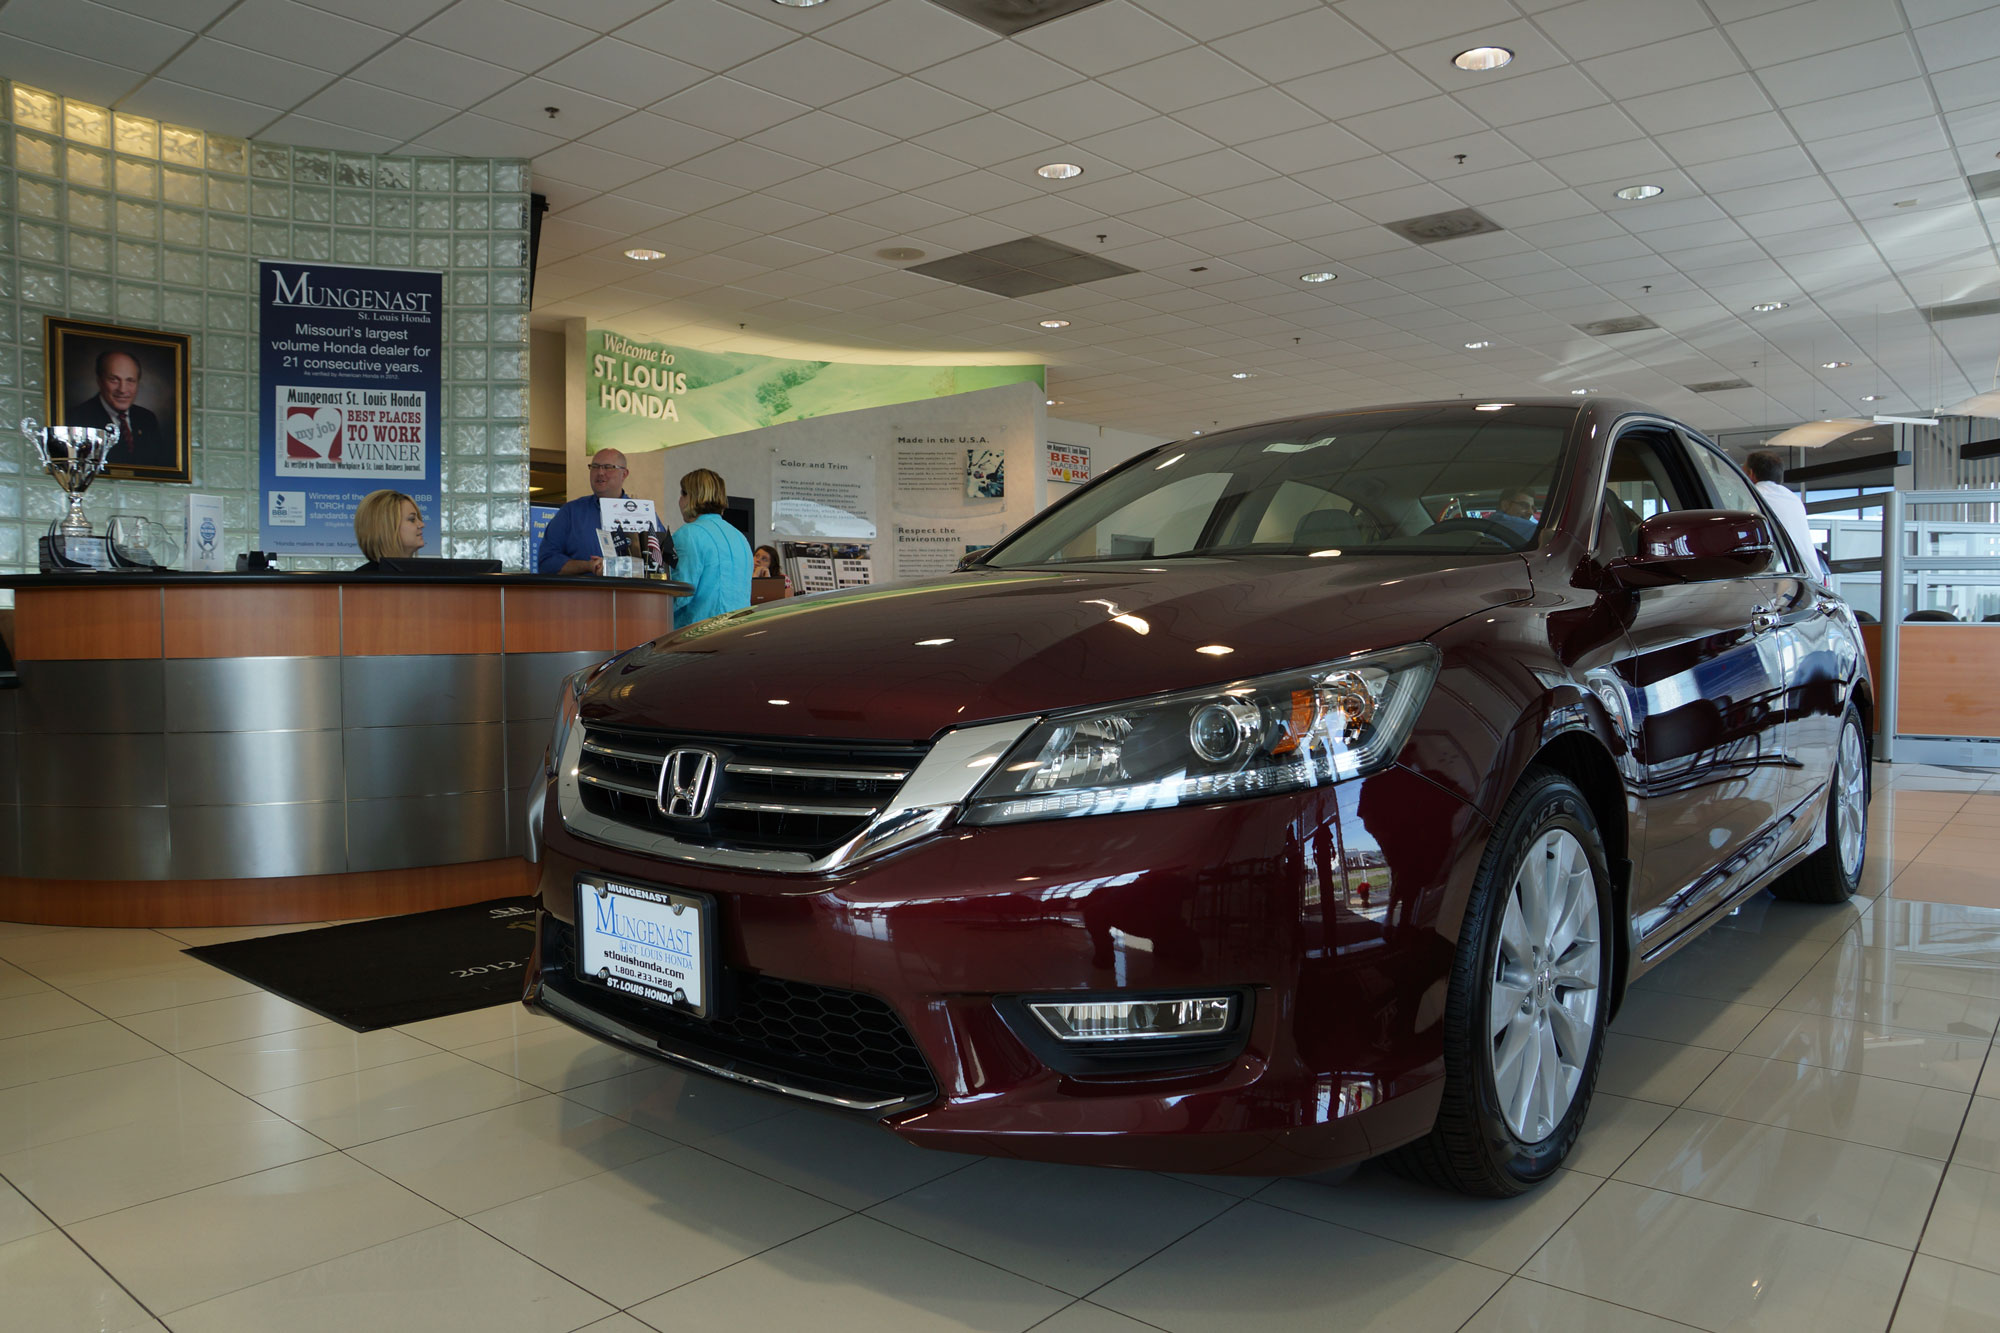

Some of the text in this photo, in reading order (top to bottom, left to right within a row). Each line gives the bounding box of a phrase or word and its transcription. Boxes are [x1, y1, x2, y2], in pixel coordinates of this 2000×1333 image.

[272, 270, 432, 312] MUNGENAST
[358, 312, 431, 323] St. Louis Honda
[295, 323, 408, 342] Missouri's largest
[271, 340, 431, 357] volume Honda dealer for
[604, 333, 675, 366] Welcome to
[282, 356, 423, 374] 21 consecutive years.
[594, 354, 687, 395] ST. LOUIS
[287, 388, 421, 407] Mungenast St. Louis Honda
[601, 385, 679, 422] HONDA
[347, 410, 421, 424] BEST PLACES
[295, 421, 336, 441] my job
[347, 425, 421, 443] TO WORK
[897, 436, 923, 444] Made
[938, 436, 955, 444] the
[958, 436, 990, 444] U.S.A.
[347, 443, 421, 462] WINNER
[1050, 452, 1088, 465] BEST
[780, 459, 848, 470] Color and Trim
[1050, 461, 1079, 470] PLACES
[308, 492, 340, 500] Winners
[415, 494, 433, 502] BBB
[314, 502, 344, 510] TORCH
[309, 512, 348, 520] standards
[898, 527, 932, 535] Respect
[898, 535, 961, 543] Environment
[607, 883, 668, 904] MUNGENAST
[593, 892, 692, 954] MUNGENAST
[603, 949, 685, 981] stlouishonda.com
[629, 943, 639, 955] ST.
[640, 946, 663, 962] LOUIS
[664, 952, 693, 970] HONDA
[450, 960, 523, 978] 2012
[607, 977, 673, 1005] ST. LOUIS HONDA
